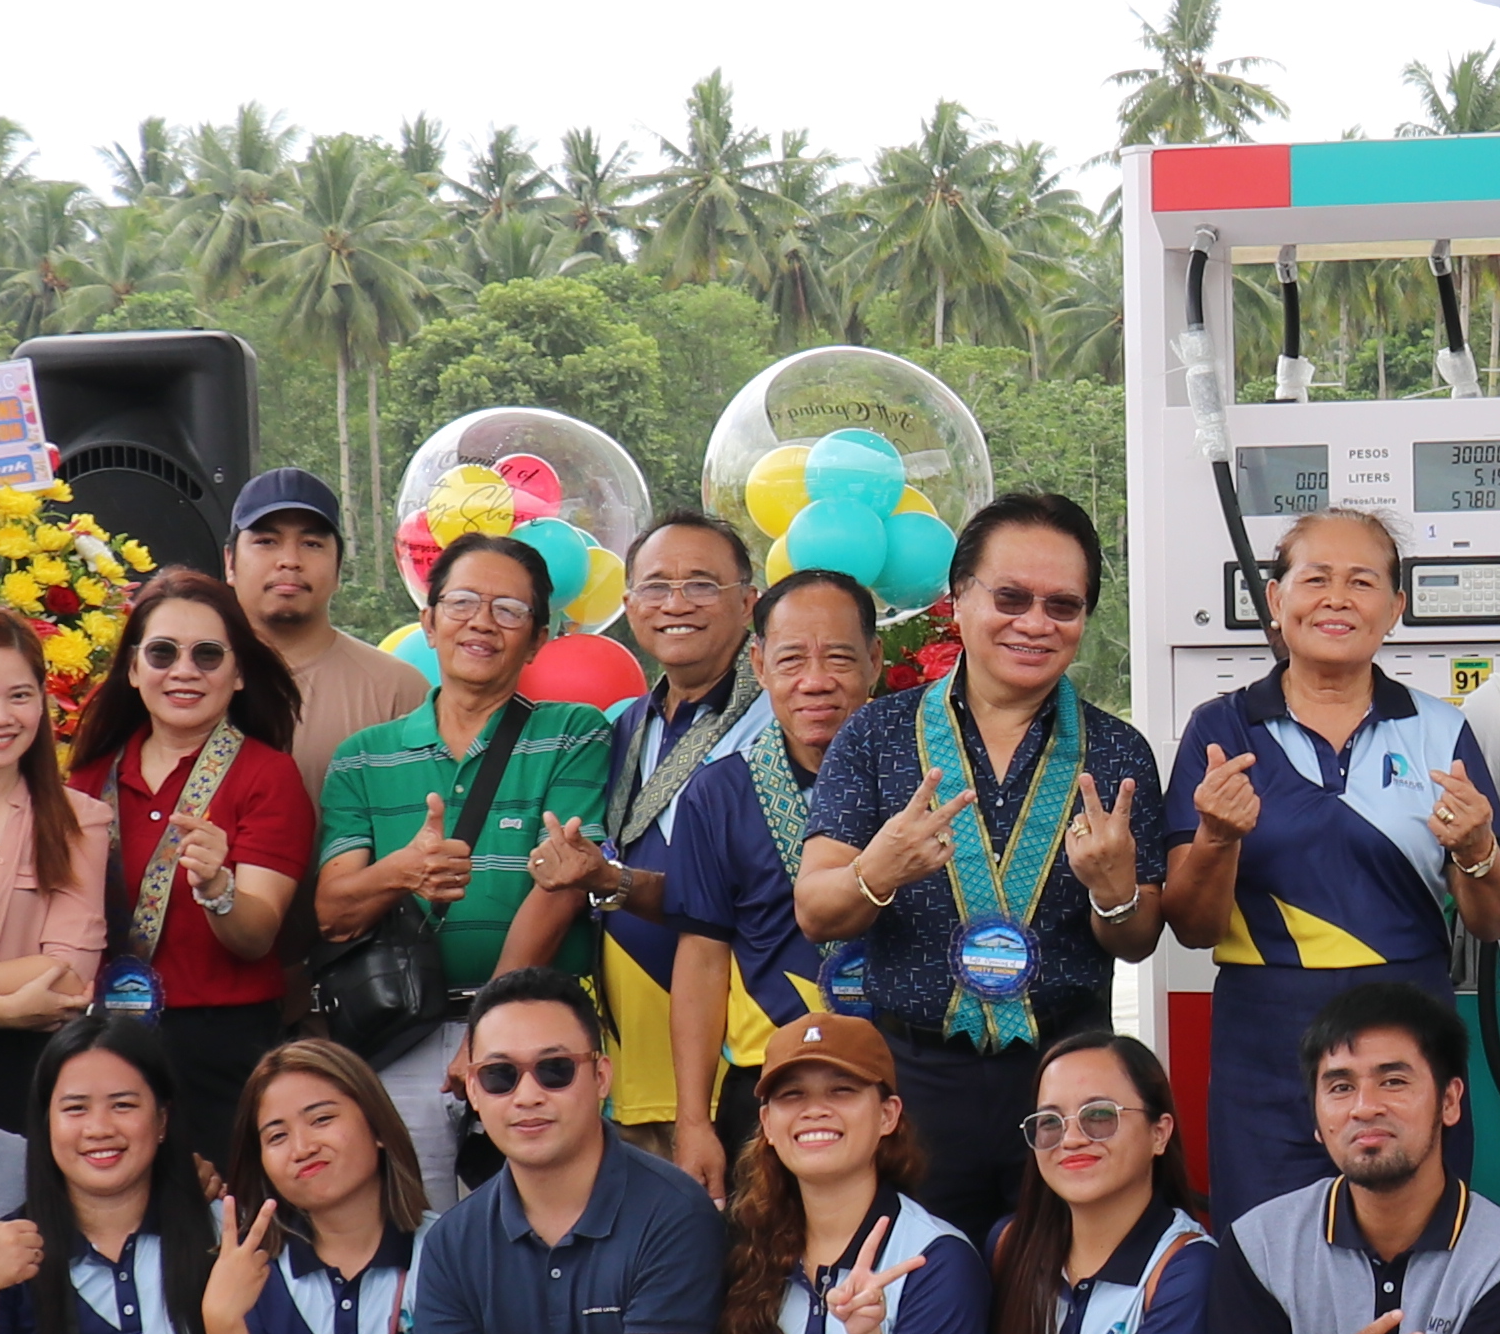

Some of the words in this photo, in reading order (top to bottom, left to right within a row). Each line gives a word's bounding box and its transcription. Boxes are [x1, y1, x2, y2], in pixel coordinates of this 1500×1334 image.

[1348, 448, 1390, 460] PESOS
[1295, 472, 1329, 490] 0.00
[1348, 472, 1391, 484] LITERS
[1343, 496, 1398, 506] Pesos/Liters
[1455, 670, 1481, 690] 91
[803, 1026, 822, 1043] A
